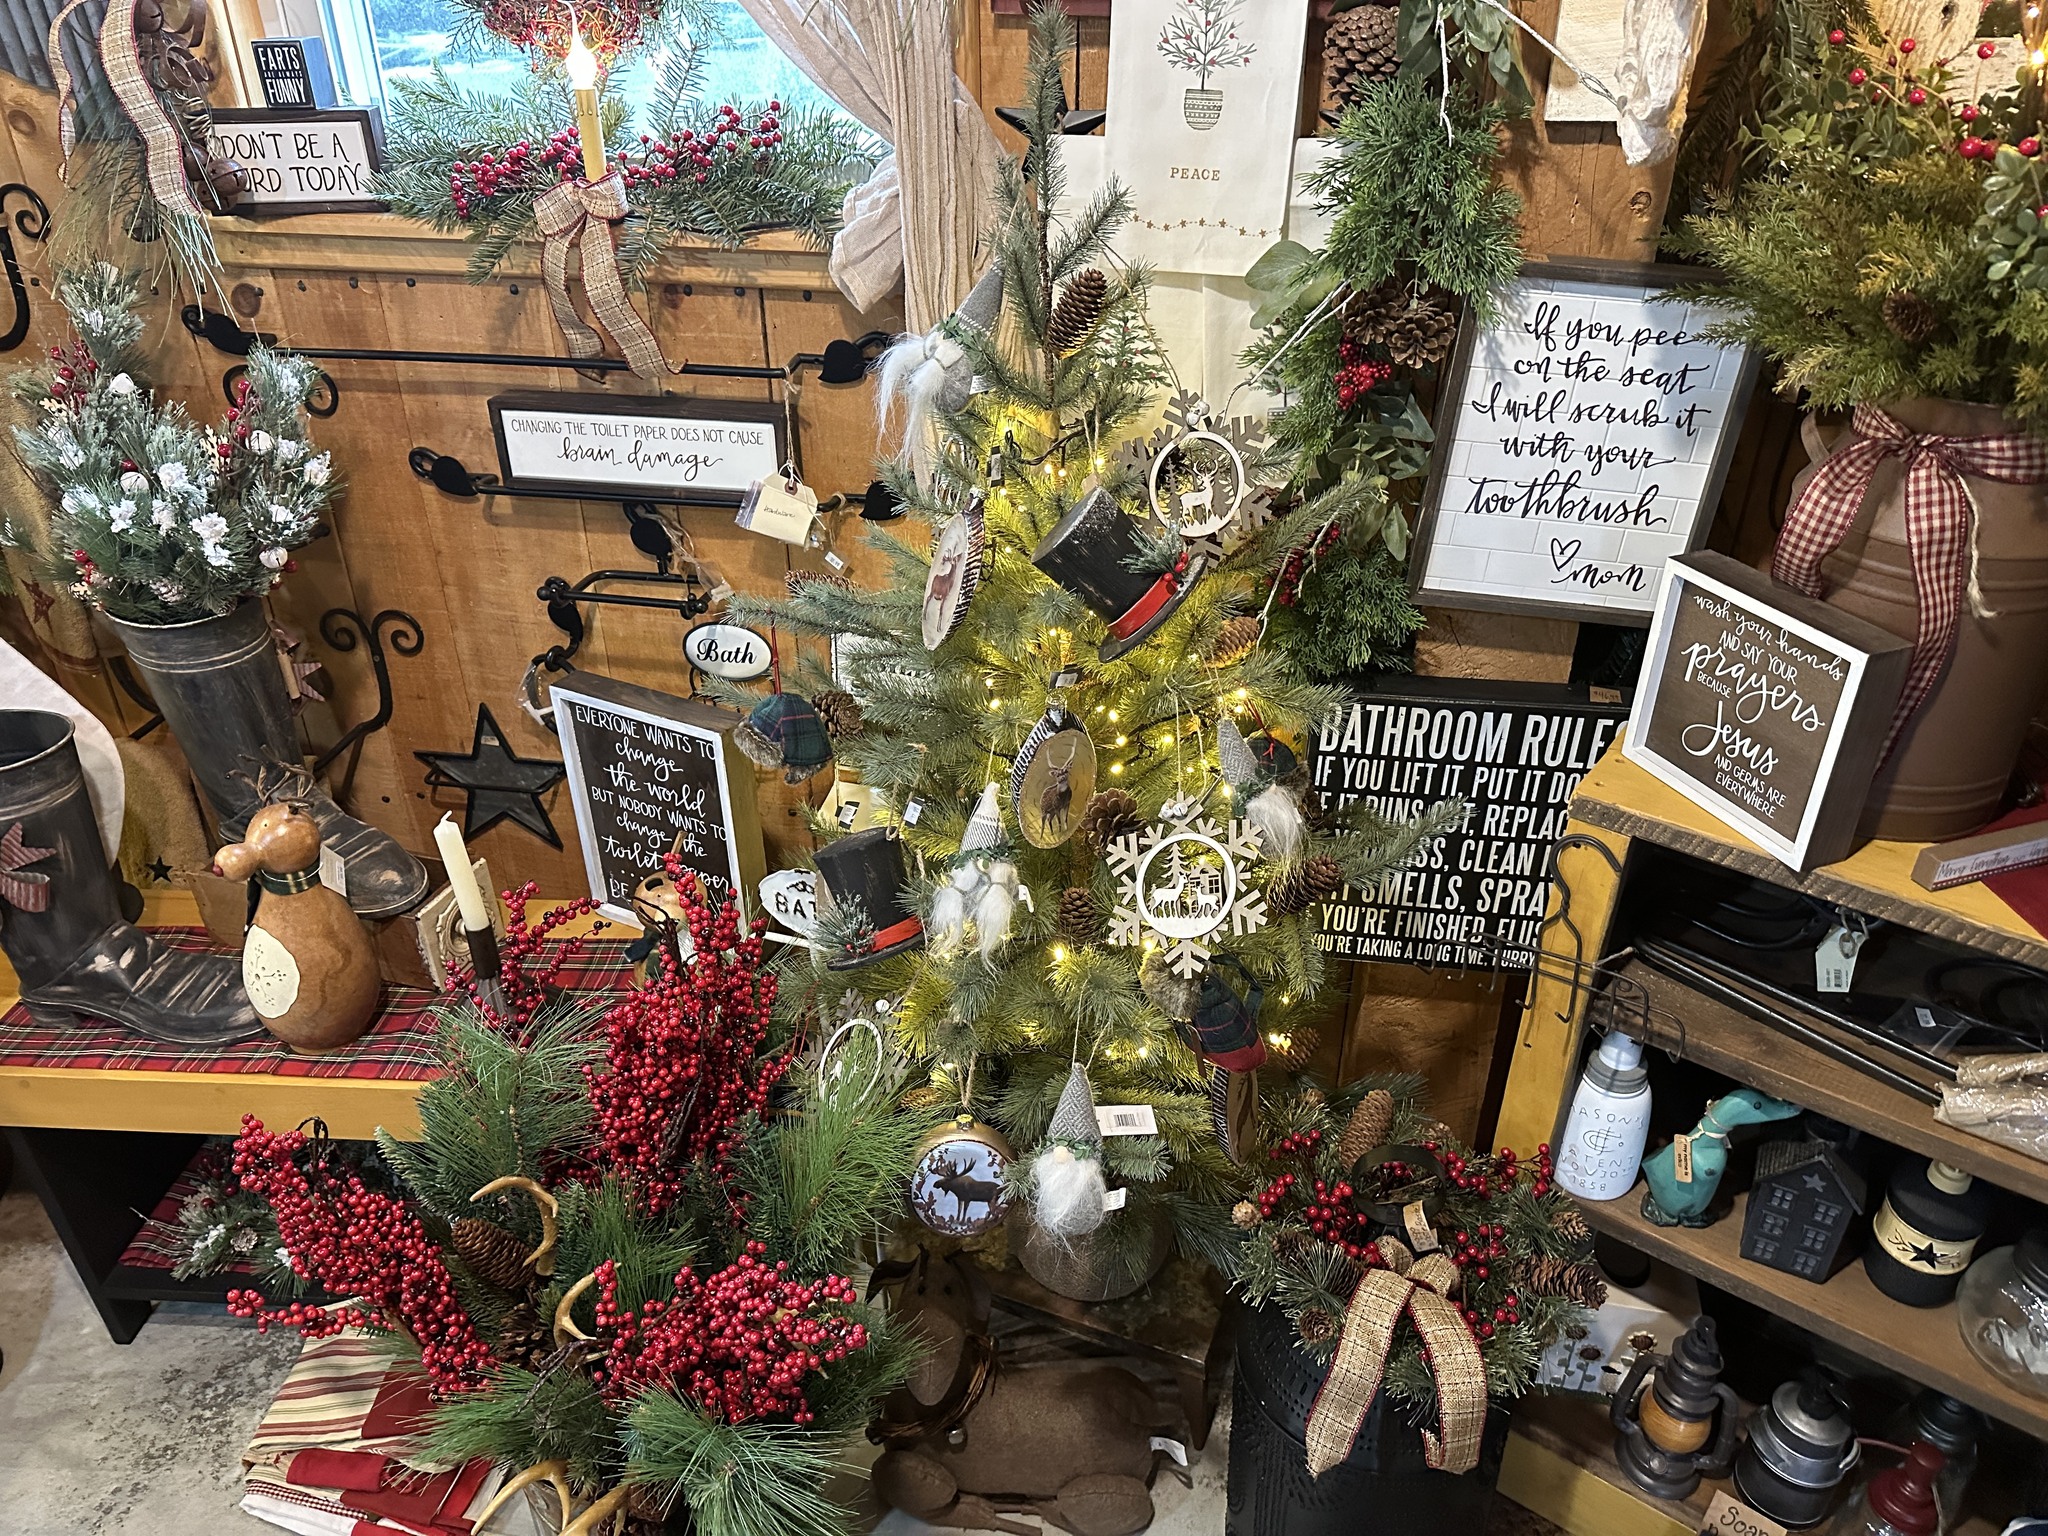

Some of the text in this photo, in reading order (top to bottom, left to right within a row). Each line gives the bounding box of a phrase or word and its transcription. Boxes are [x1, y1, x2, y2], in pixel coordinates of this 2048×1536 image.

[257, 47, 300, 70] FARTS
[266, 78, 306, 103] FUNNY
[221, 131, 350, 162] DON'T BE A
[243, 163, 361, 195] URD TODAY
[1170, 167, 1220, 181] PEACE
[1524, 301, 1700, 356] If you pee
[1514, 351, 1710, 395] on the seat
[1472, 382, 1711, 436] I will scrub it
[511, 418, 764, 446] CHANGING THE TOILET PAPER DOES NOT CAUSE
[1500, 431, 1676, 476] with your
[557, 437, 723, 482] brain damage
[1465, 469, 1667, 526] toothbrush
[1551, 563, 1646, 592] mom
[696, 638, 758, 665] Bath
[1694, 594, 1843, 681] wash your hands
[1719, 630, 1797, 686] AND SAY YOUR
[1681, 642, 1825, 732] prayers
[1697, 671, 1731, 699] BECAUSE
[575, 704, 716, 761] EVERYONE WANTS TO
[1319, 701, 1629, 769] BATHROOM RULE
[1682, 700, 1779, 776] Jesus
[615, 737, 684, 782] change
[1314, 755, 1587, 804] IF YOU LIFT IT, PUT IT DO
[1714, 755, 1787, 808] AND GERMS ARE
[603, 763, 706, 818] the world
[1716, 774, 1776, 820] EVERYWHERE
[591, 786, 727, 841] BUT NOBODY WANTS TO
[616, 812, 708, 858] change the
[1482, 804, 1568, 840] REPLAC
[601, 835, 664, 870] toilet
[1458, 838, 1536, 876] CLEAN
[775, 892, 817, 920] BAT
[1477, 877, 1553, 917] SPRA
[1322, 903, 1390, 936] YOU'RE
[1357, 937, 1402, 957] TAKING
[1404, 942, 1412, 959] A
[1416, 943, 1451, 961] LONG
[1569, 1148, 1635, 1168] ATENT
[1573, 1176, 1606, 1191] 1858
